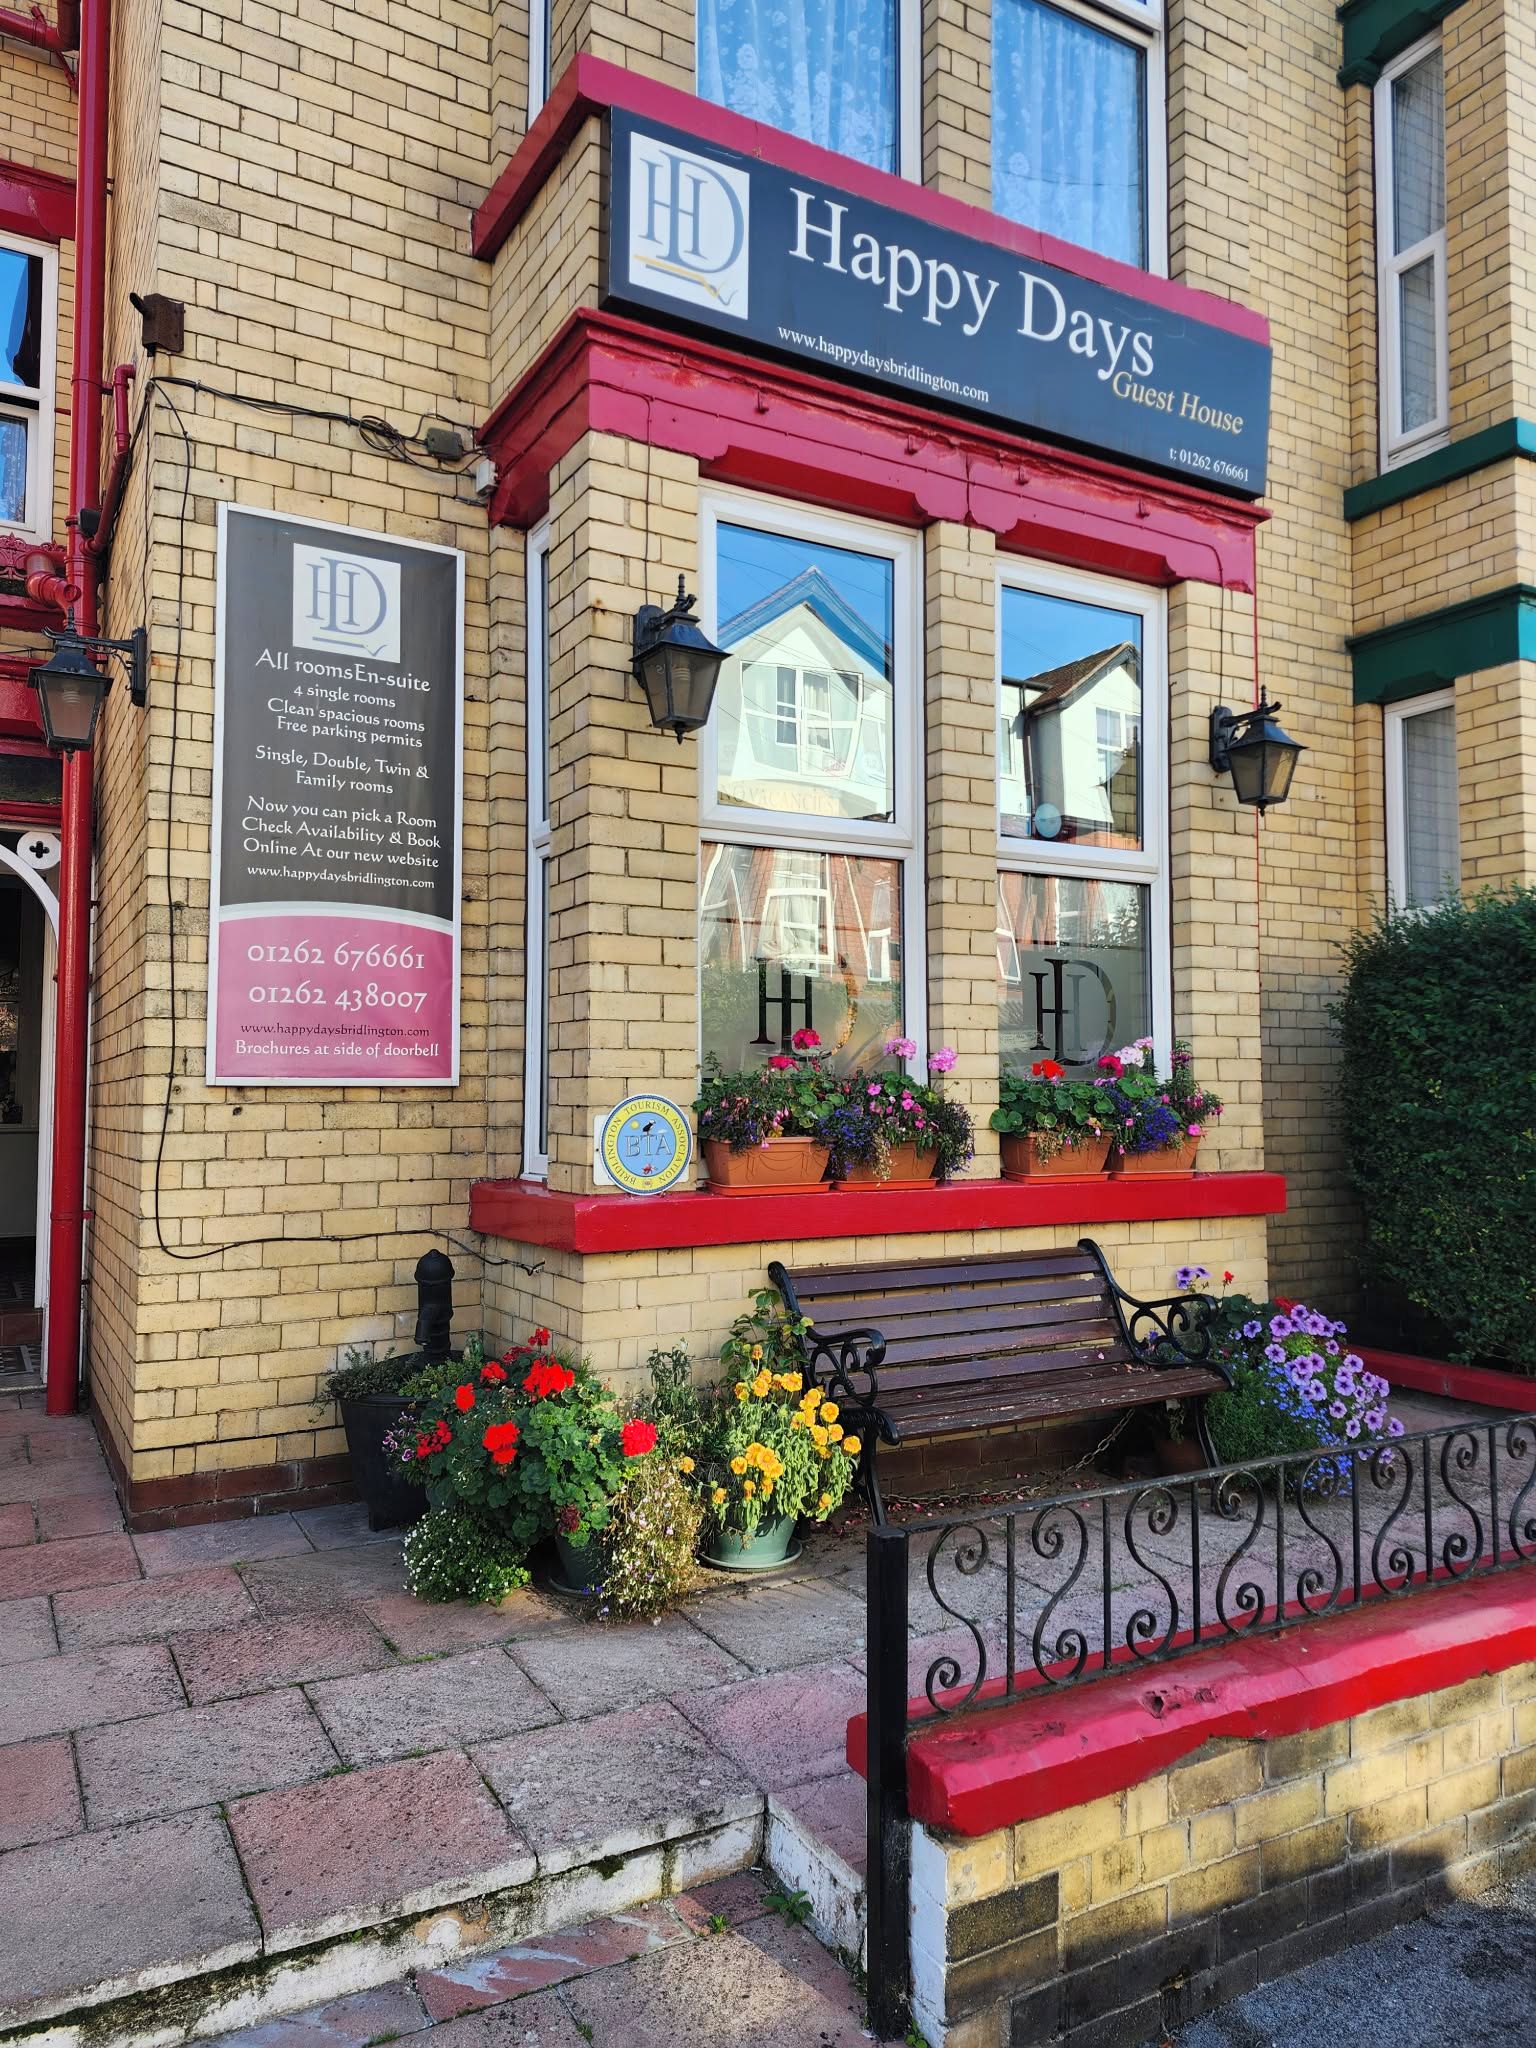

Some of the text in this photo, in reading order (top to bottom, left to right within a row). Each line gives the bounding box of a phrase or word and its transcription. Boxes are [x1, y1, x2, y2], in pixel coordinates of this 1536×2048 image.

[788, 187, 1154, 380] Happy Days
[777, 326, 989, 403] www.happydaysbridlington.com
[1112, 371, 1244, 435] Guest House
[1180, 449, 1211, 470] 01262
[1213, 460, 1249, 482] 676661
[255, 648, 431, 692] All rooms En-suite
[293, 684, 396, 708] 4 single rooms
[267, 697, 426, 732] Clean spacious rooms
[277, 715, 423, 748] Free parking permits
[255, 745, 430, 779] Single, Double, Twin &
[296, 770, 393, 794] Family rooms
[247, 795, 437, 828] Now you can pick a Room
[242, 816, 442, 849] Check Availability & Book
[243, 837, 440, 868] Online At our new website
[247, 865, 436, 889] www.happydaysbridlington.com
[247, 939, 425, 972] 01262 676661
[249, 980, 428, 1013] 01262 438007
[241, 1022, 430, 1038] www.happydaysbridlington.com
[235, 1040, 439, 1058] Brochures at side of doorbell
[606, 1100, 686, 1185] BRIDLINGTON TOURISM ASSOCIATION
[624, 1133, 673, 1157] BTA
